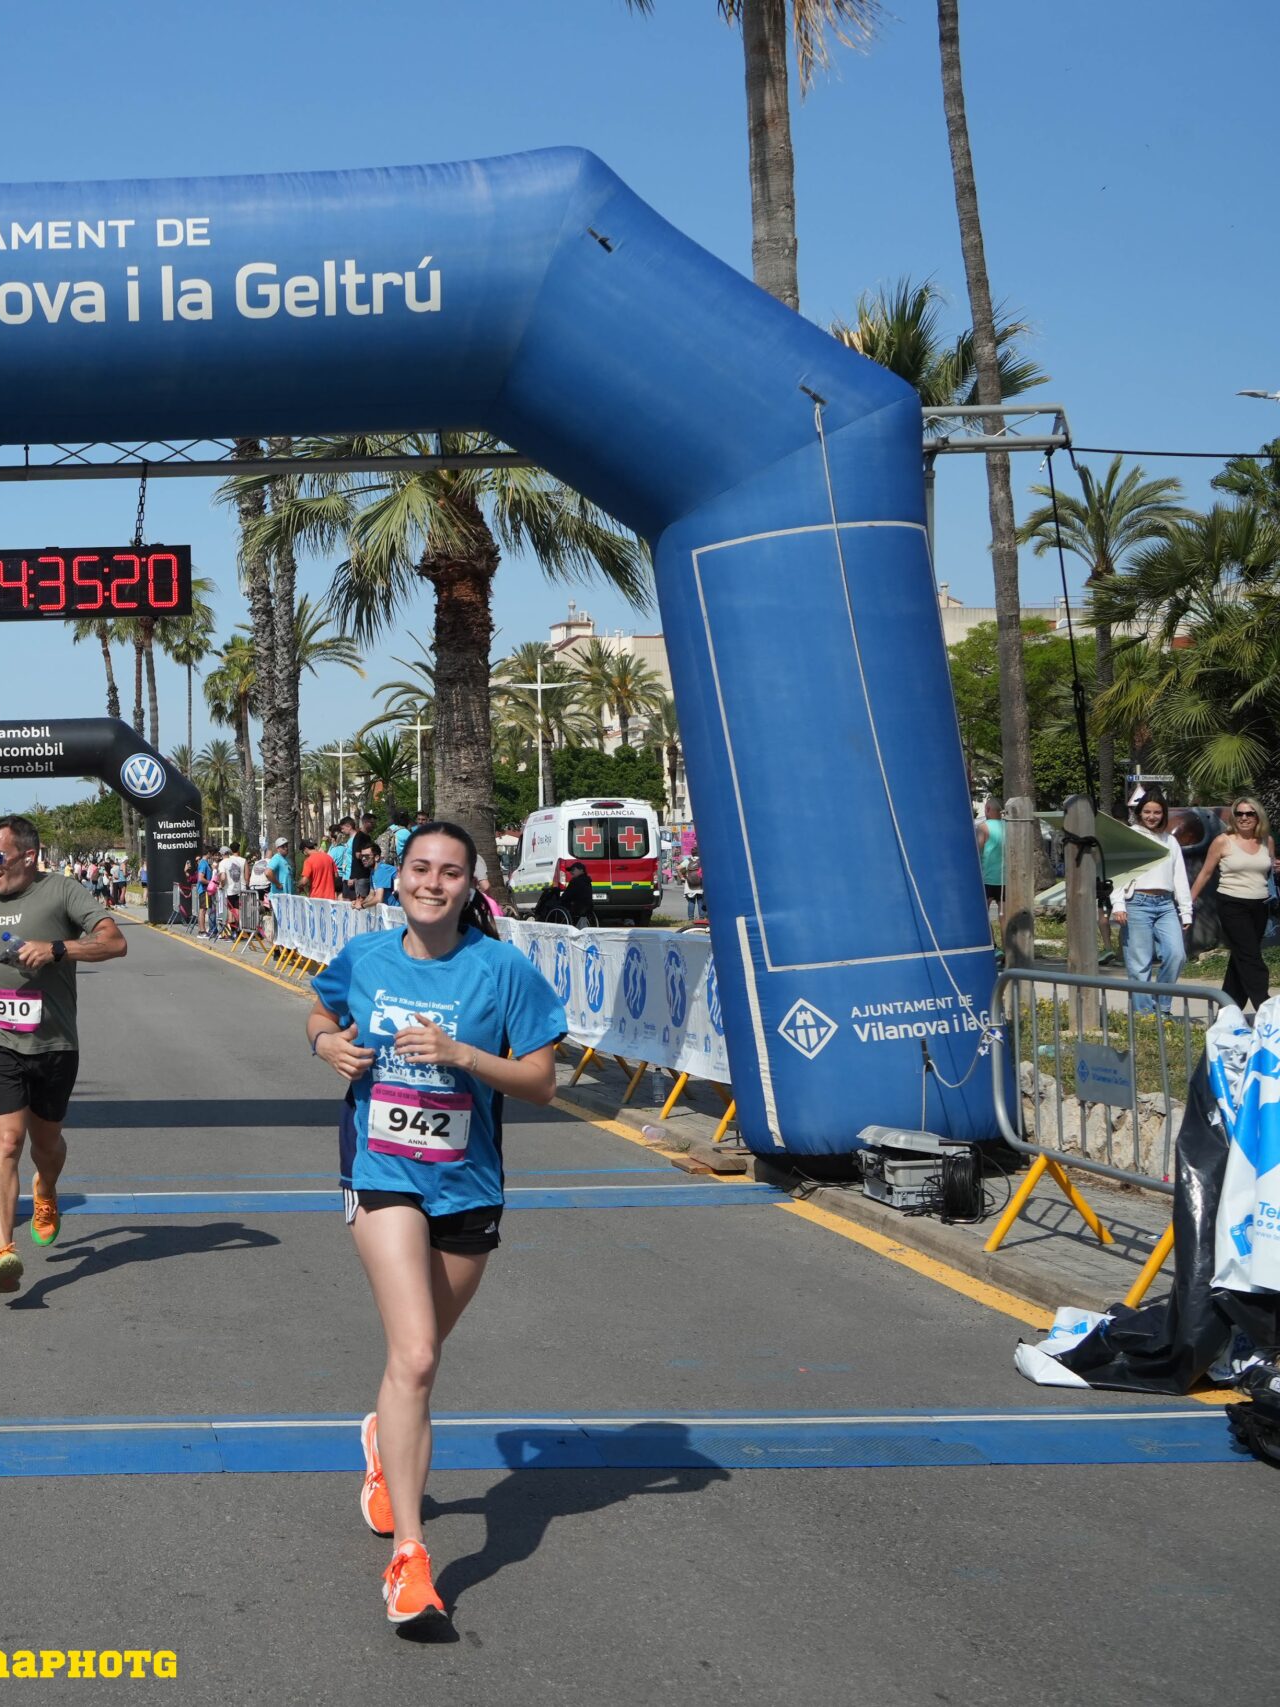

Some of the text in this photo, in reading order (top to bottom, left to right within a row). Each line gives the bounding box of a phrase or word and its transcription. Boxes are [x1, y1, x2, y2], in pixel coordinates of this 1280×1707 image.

[156, 217, 211, 247] DE
[126, 265, 140, 322] i
[161, 265, 213, 321] la
[235, 255, 442, 319] Geltrú
[152, 830, 200, 840] Tarracomòbil
[158, 820, 196, 829] Vilamòbil
[157, 841, 198, 850] Reusmòbil
[851, 997, 953, 1019] AJUNTAMENT
[853, 1020, 950, 1043] Vilanova
[388, 1107, 451, 1138] 942
